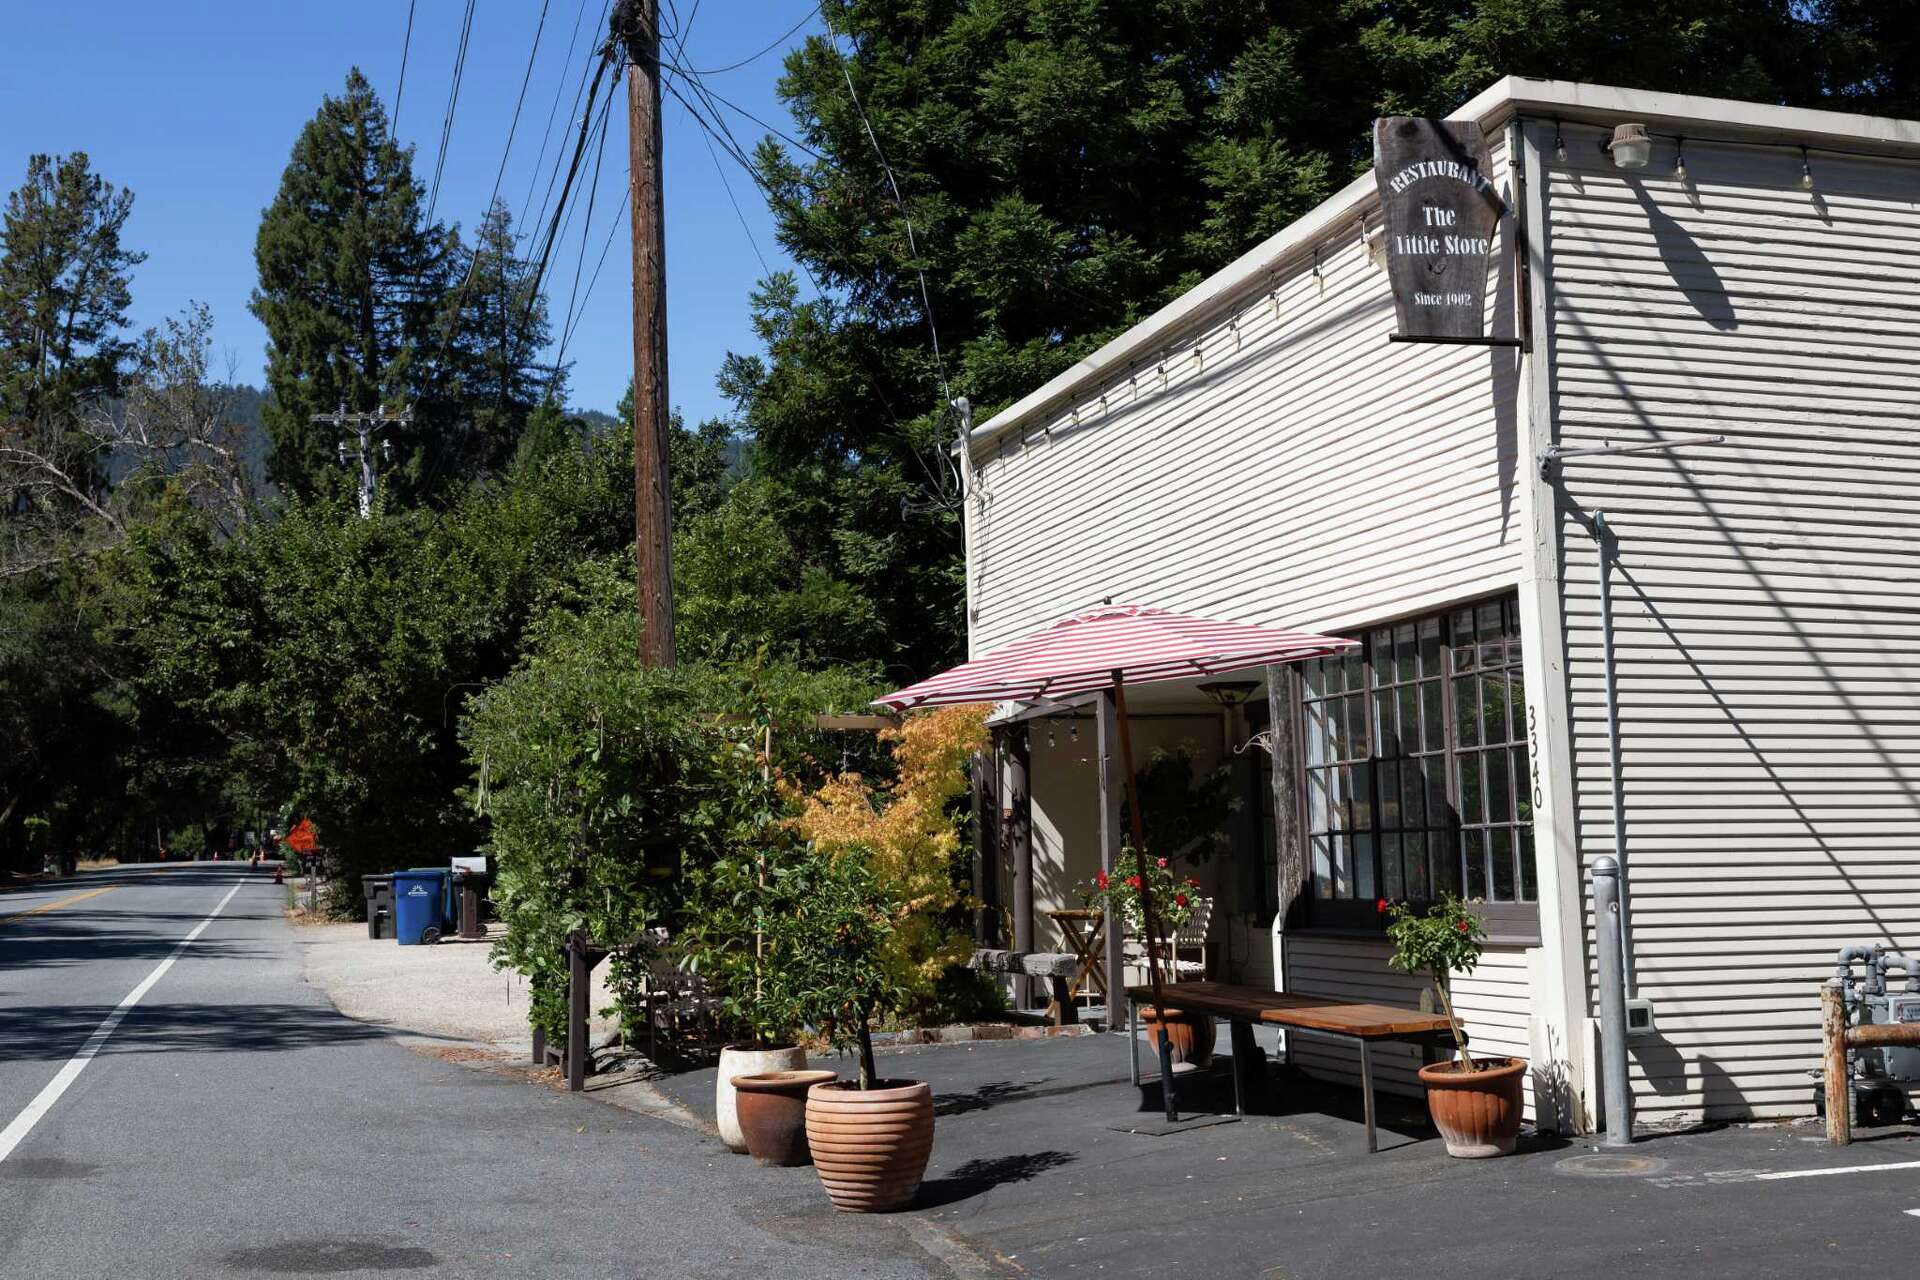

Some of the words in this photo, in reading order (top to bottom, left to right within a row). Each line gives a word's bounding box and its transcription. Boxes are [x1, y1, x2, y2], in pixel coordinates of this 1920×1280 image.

[1390, 161, 1492, 193] RESTAURANT
[1422, 206, 1456, 226] The
[1396, 234, 1440, 255] Little
[1444, 234, 1488, 255] Store
[1414, 292, 1442, 306] Since
[1446, 293, 1472, 306] 1902
[1528, 705, 1543, 809] 3340
